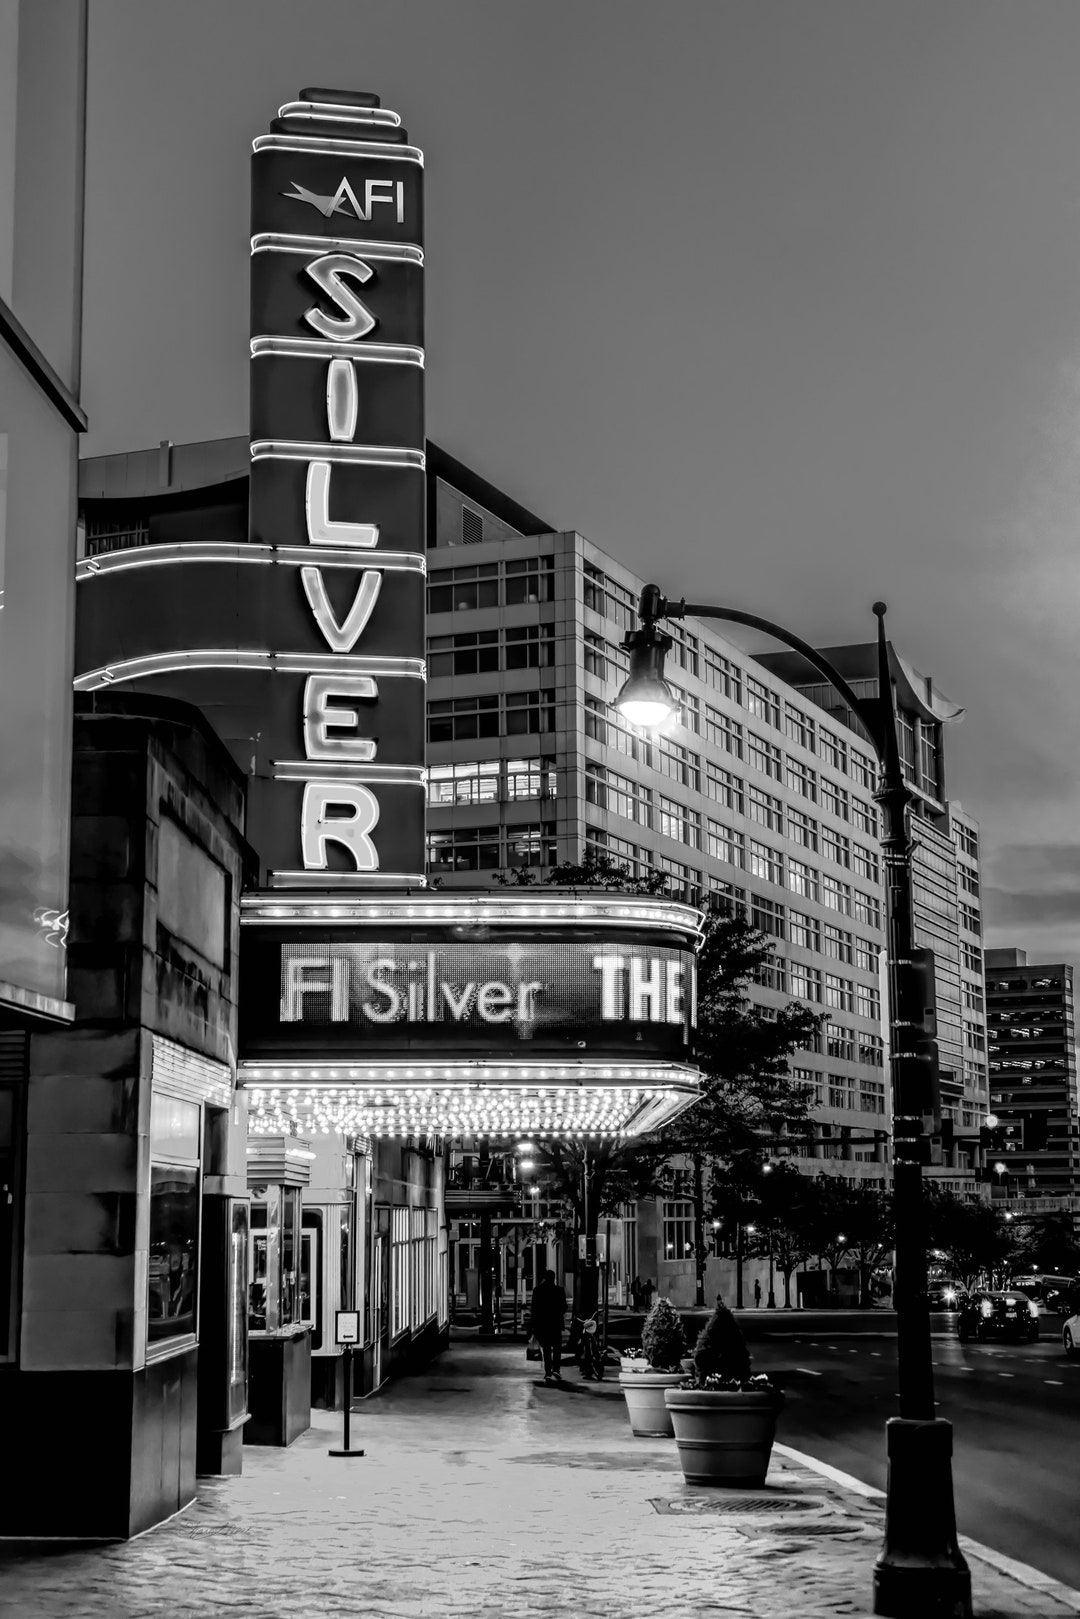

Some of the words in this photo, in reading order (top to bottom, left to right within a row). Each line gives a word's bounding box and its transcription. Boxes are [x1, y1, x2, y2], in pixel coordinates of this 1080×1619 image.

[325, 176, 405, 223] AFI
[300, 252, 383, 871] SILVER
[362, 951, 543, 1023] Silver
[593, 956, 685, 1024] THE
